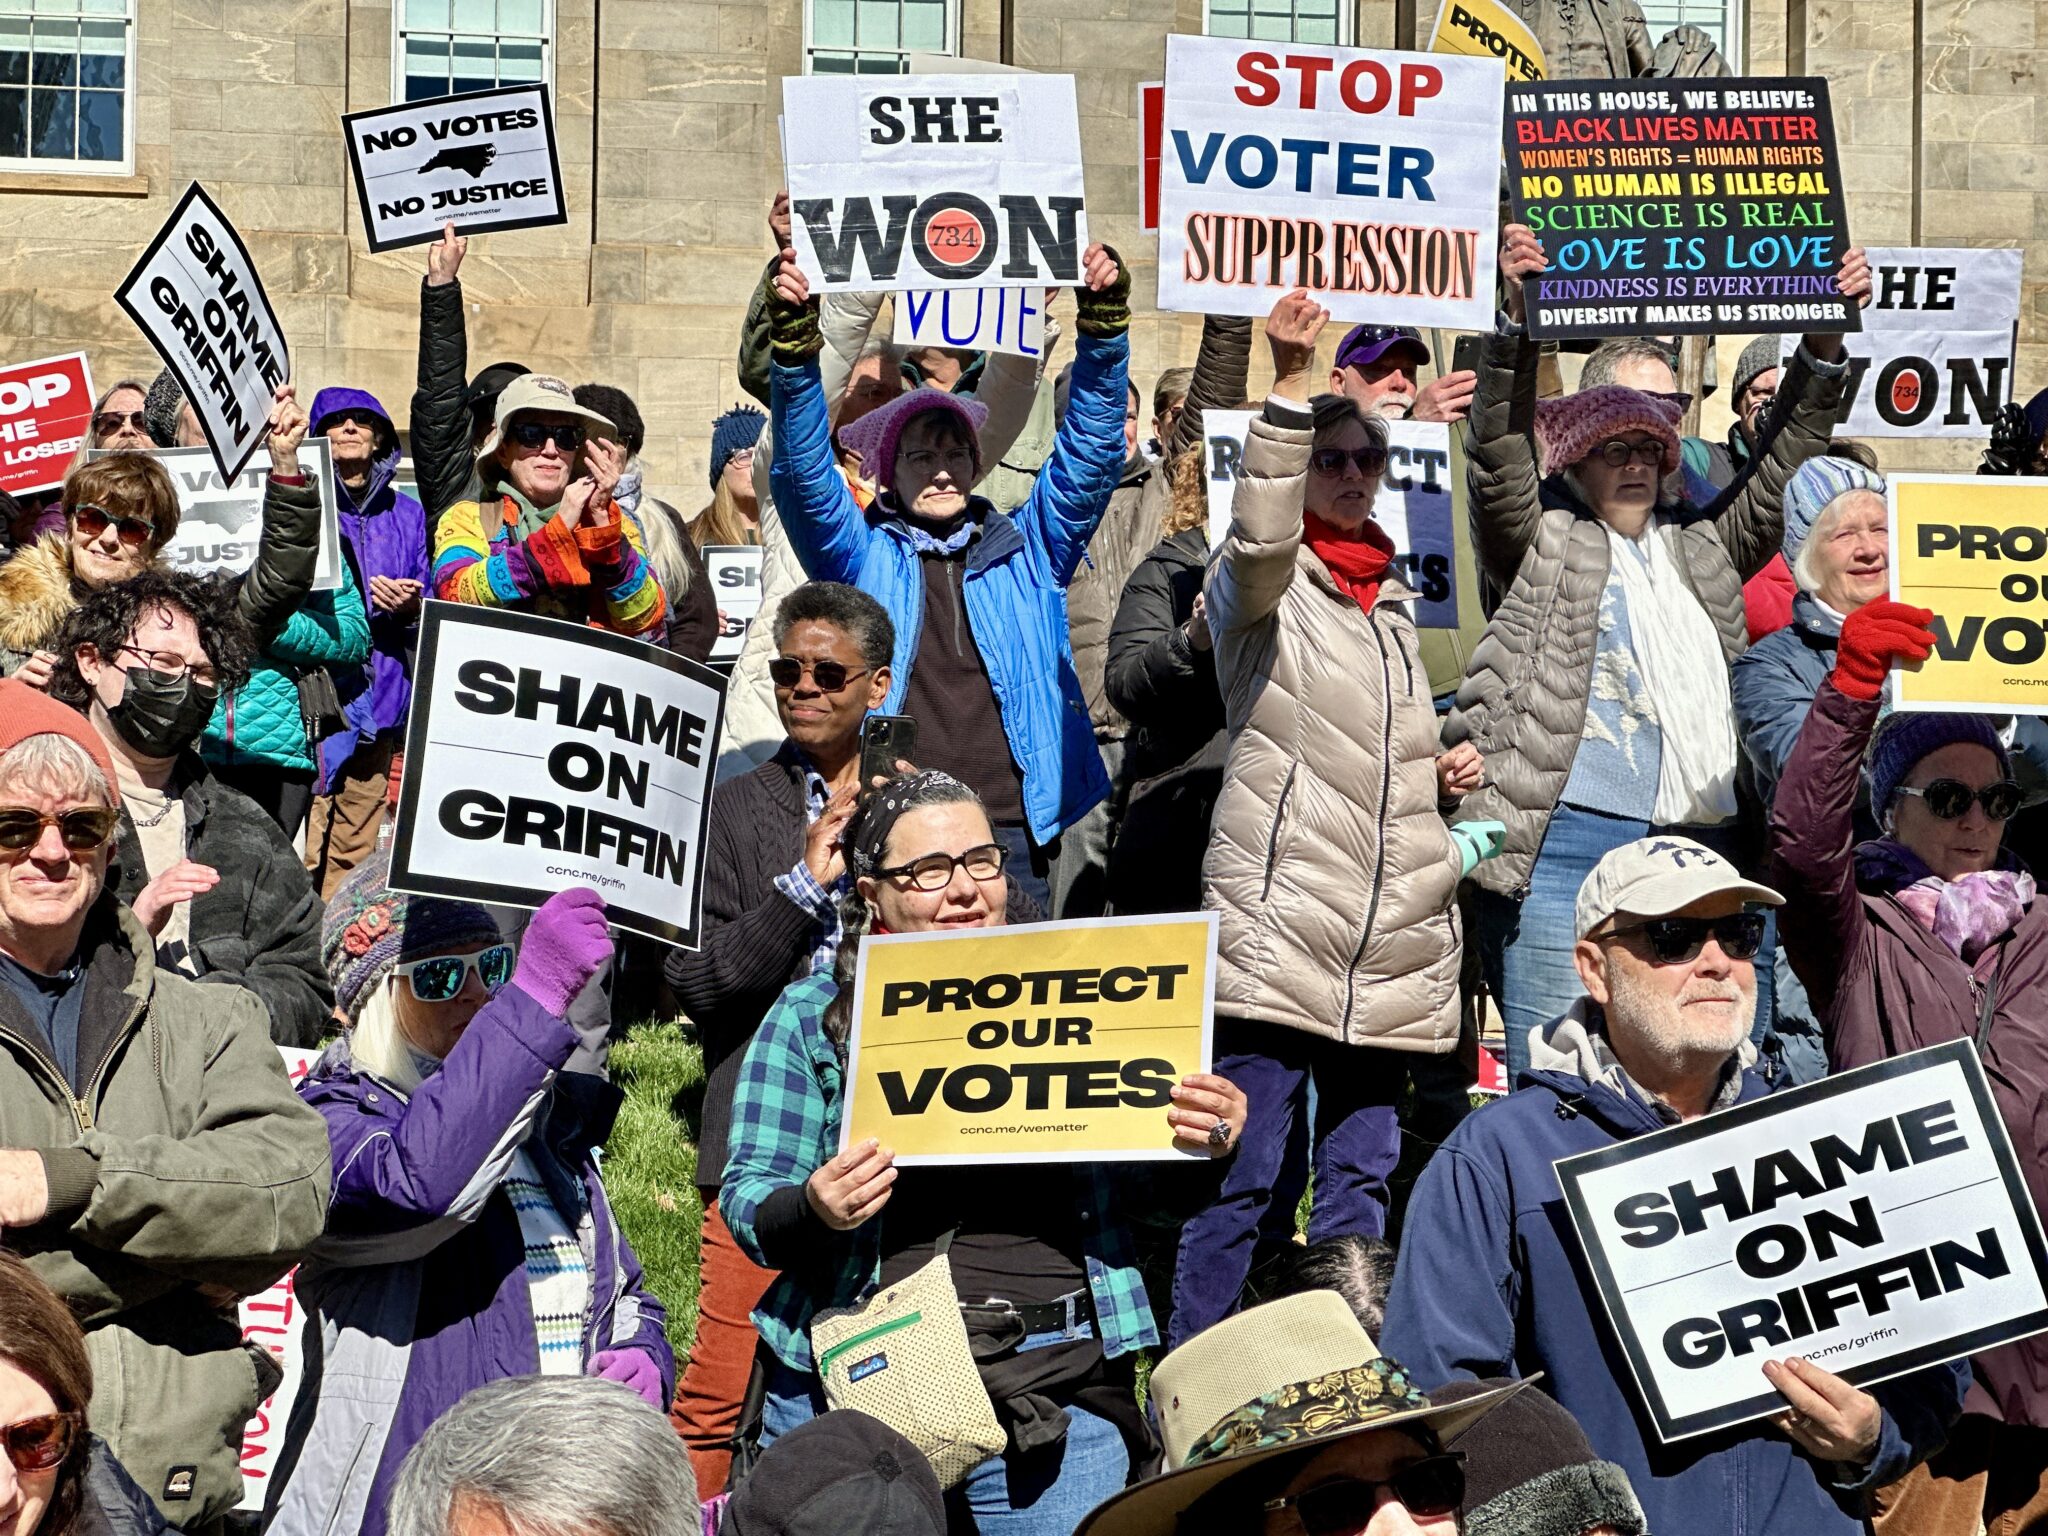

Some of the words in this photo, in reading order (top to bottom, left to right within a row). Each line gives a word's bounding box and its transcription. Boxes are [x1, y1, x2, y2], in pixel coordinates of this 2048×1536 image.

[1234, 52, 1443, 117] STOP
[1512, 93, 1537, 112] IN
[1544, 92, 1592, 112] THIS
[1599, 91, 1678, 113] HOUSE,
[1683, 91, 1718, 110] WE
[1725, 90, 1815, 110] BELIEVE:
[362, 127, 417, 154] NO
[422, 108, 539, 141] VOTES
[869, 96, 1003, 145] SHE
[1516, 117, 1614, 144] BLACK
[1619, 116, 1699, 142] LIVES
[1704, 116, 1818, 142] MATTER
[1170, 129, 1437, 202] VOTER
[1519, 148, 1606, 169] WOMEN'S
[1610, 147, 1673, 167] RIGHTS
[1694, 147, 1759, 166] HUMAN
[1762, 146, 1824, 166] RIGHTS
[377, 197, 425, 221] NO
[431, 178, 548, 210] JUSTICE
[1521, 175, 1563, 199] NO
[1573, 173, 1682, 197] HUMAN
[1690, 173, 1716, 196] IS
[1724, 172, 1830, 195] ILLEGAL
[793, 191, 1084, 283] WON
[931, 225, 977, 248] 734
[1525, 203, 1683, 231] SCIENCE
[1694, 202, 1728, 228] IS
[1740, 202, 1834, 228] REAL
[1183, 212, 1479, 299] SUPPRESSION
[1663, 234, 1706, 271] IS
[1726, 234, 1834, 269] LOVE
[1538, 277, 1659, 300] KINDNESS
[1665, 276, 1687, 297] IS
[1694, 275, 1840, 297] EVERYTHING
[1860, 266, 1956, 310] HE
[185, 222, 284, 398] SHAME
[1539, 306, 1638, 326] DIVERSITY
[1646, 305, 1712, 324] MAKES
[1717, 304, 1743, 322] US
[1748, 303, 1847, 321] STRONGER
[203, 298, 246, 375] ON
[150, 275, 251, 448] GRIFFIN
[0, 373, 71, 416] OP
[1893, 385, 1919, 398] 734
[0, 418, 39, 443] HE
[177, 541, 259, 566] JUST
[454, 659, 707, 769] SHAME
[547, 741, 650, 809] ON
[438, 788, 687, 887] GRIFFIN
[545, 865, 626, 891] ccnc.me/griffin
[881, 964, 1189, 1017] PROTECT
[966, 1016, 1093, 1049] OUR
[877, 1057, 1177, 1116] VOTES
[959, 1122, 1089, 1135] ccnc.me/wematter
[1613, 1099, 1970, 1249] SHAME
[1735, 1195, 1885, 1280] ON
[1662, 1226, 2011, 1370] GRIFFIN
[1802, 1326, 1899, 1361] nc.me/griffin
